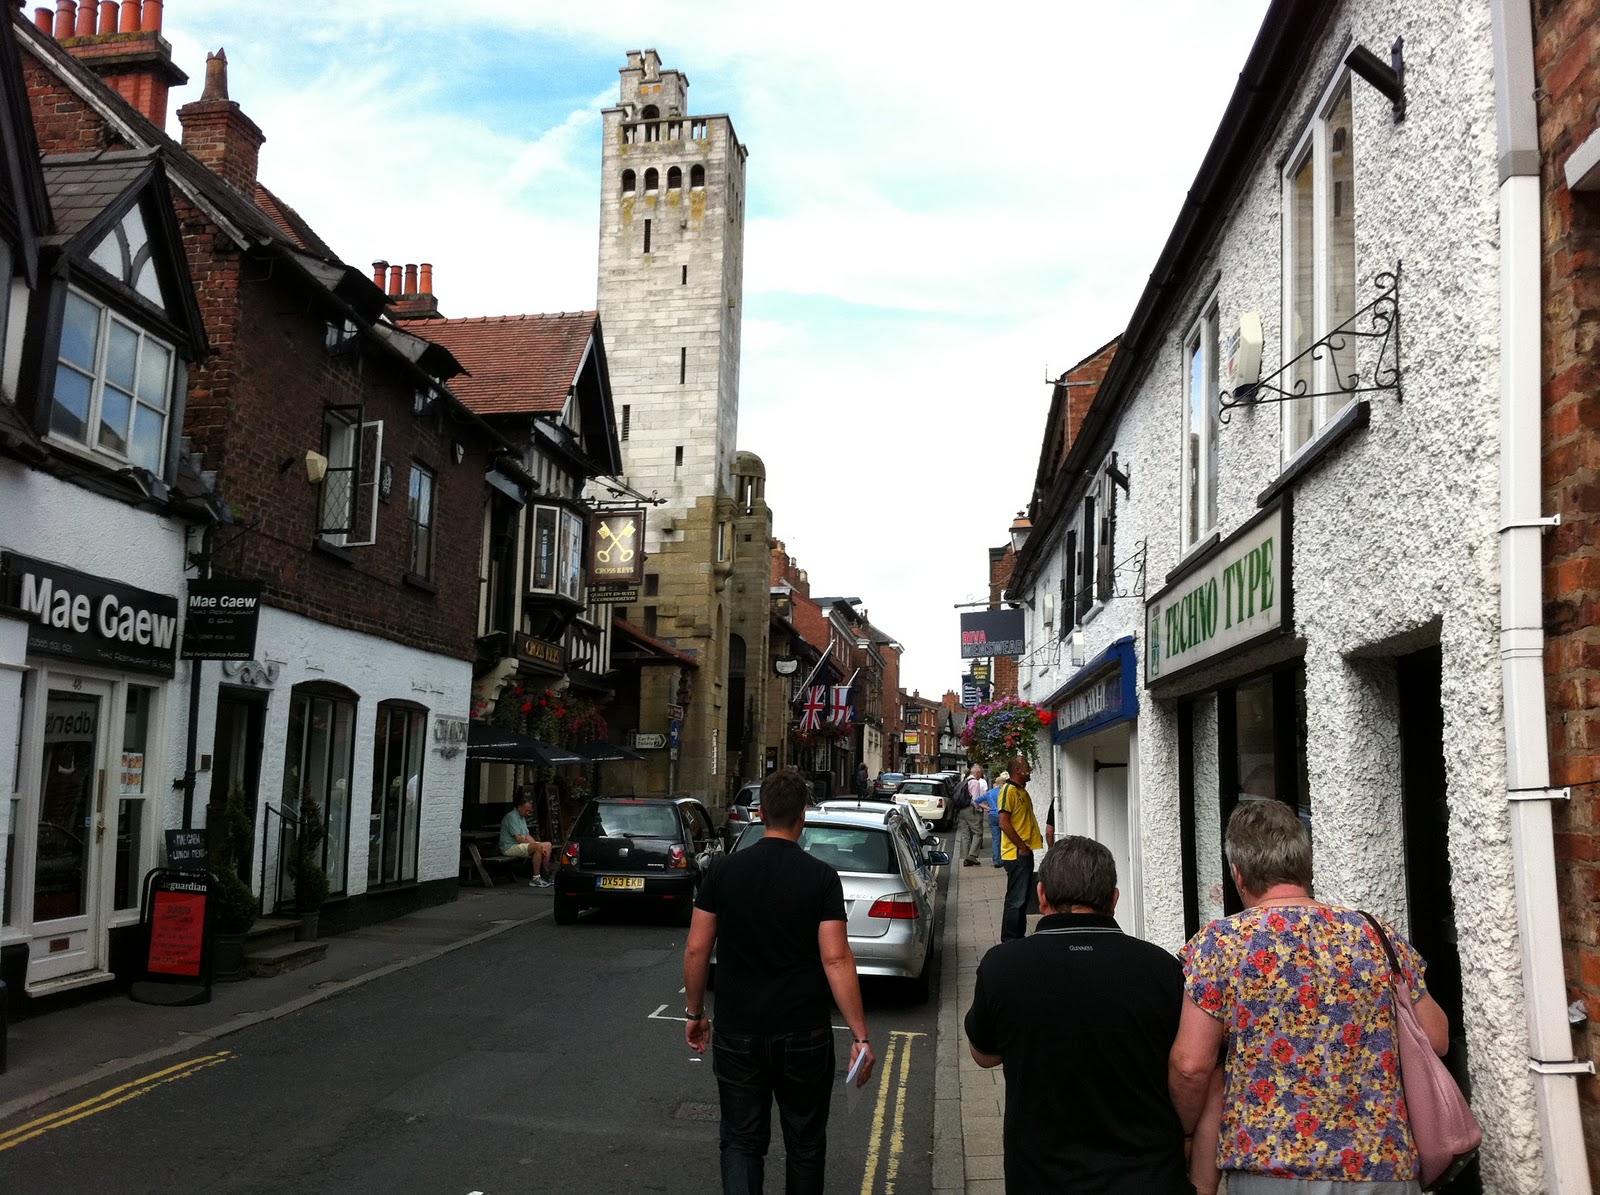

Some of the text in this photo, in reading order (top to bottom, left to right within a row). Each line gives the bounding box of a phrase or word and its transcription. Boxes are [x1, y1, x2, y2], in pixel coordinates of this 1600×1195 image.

[189, 595, 257, 608] Mae Gaew
[1165, 576, 1218, 659] TECHNO
[1223, 536, 1274, 630] TYPE
[20, 572, 177, 649] Mae Gaew
[962, 630, 987, 645] RIVA
[525, 640, 545, 659] CROSS
[962, 639, 1024, 657] MENSWEAR
[602, 877, 624, 886] DX53
